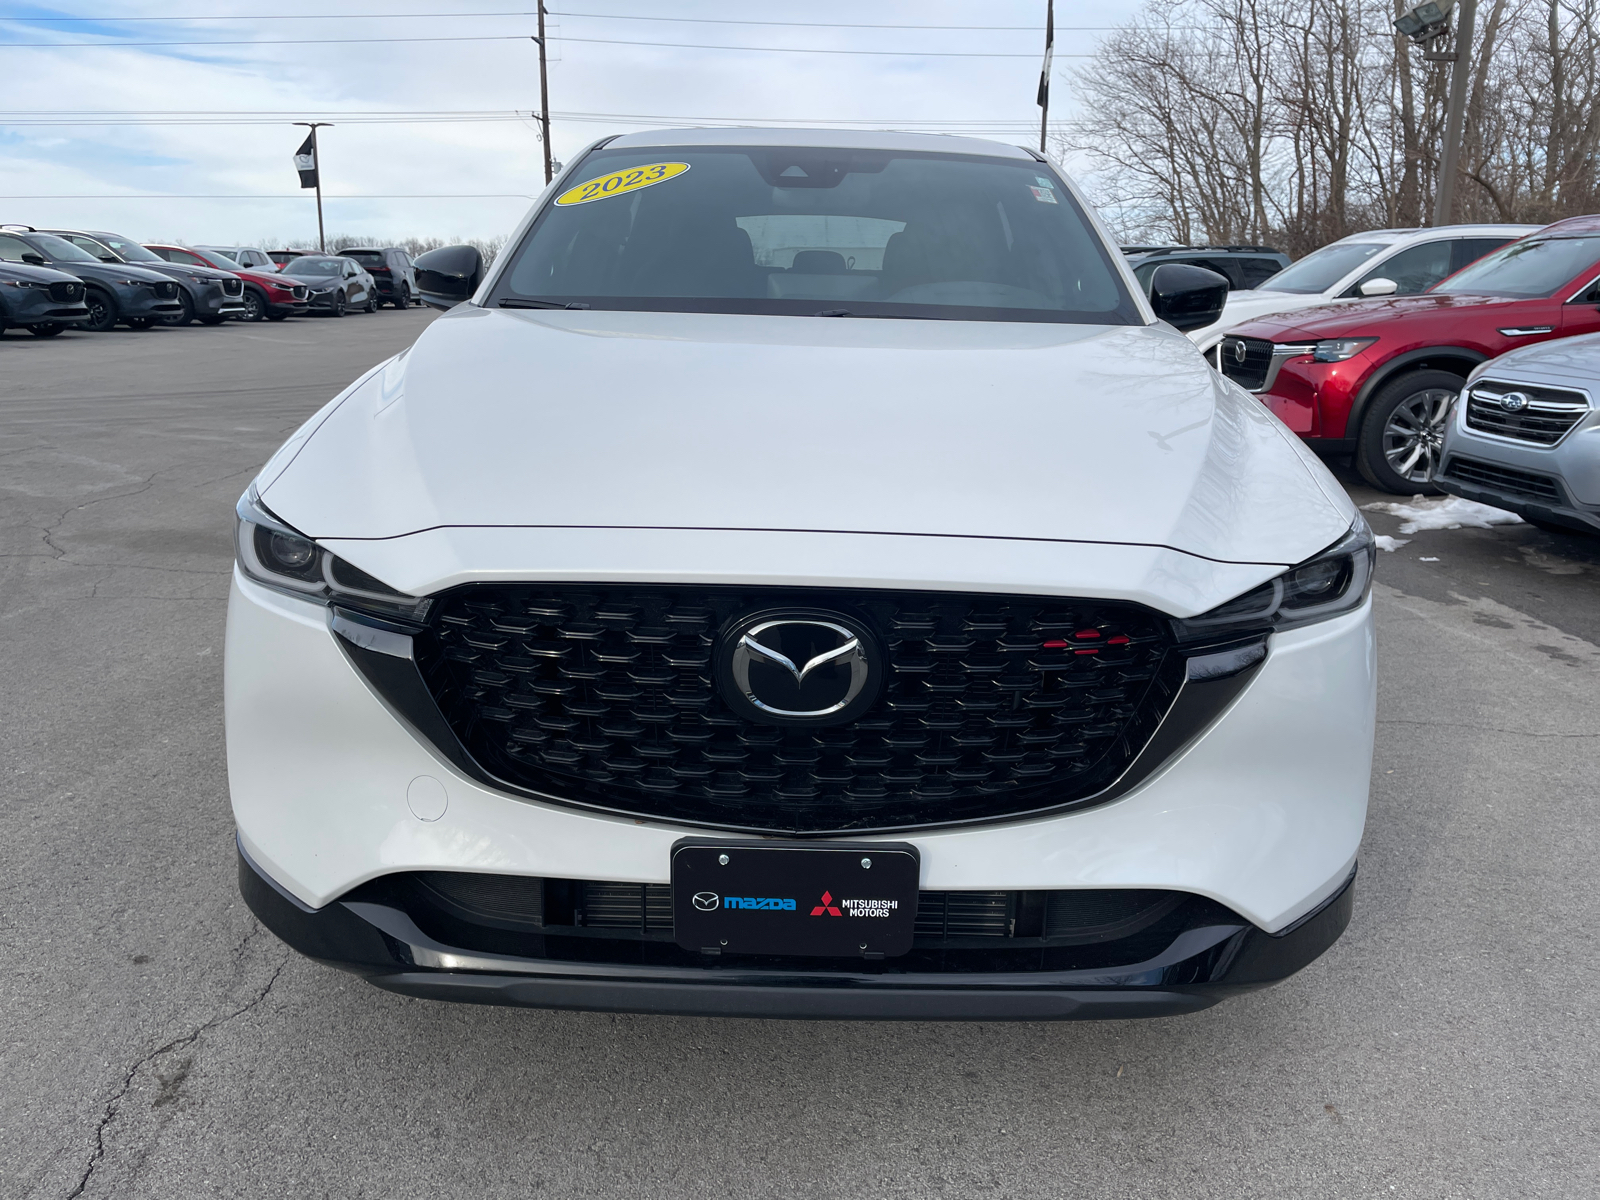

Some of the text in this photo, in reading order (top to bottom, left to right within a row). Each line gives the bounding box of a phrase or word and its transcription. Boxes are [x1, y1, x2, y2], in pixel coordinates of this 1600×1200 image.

[580, 166, 667, 200] 2023
[724, 897, 796, 911] mazda
[842, 899, 898, 909] MITSUBISHI
[849, 909, 889, 918] MOTORS
